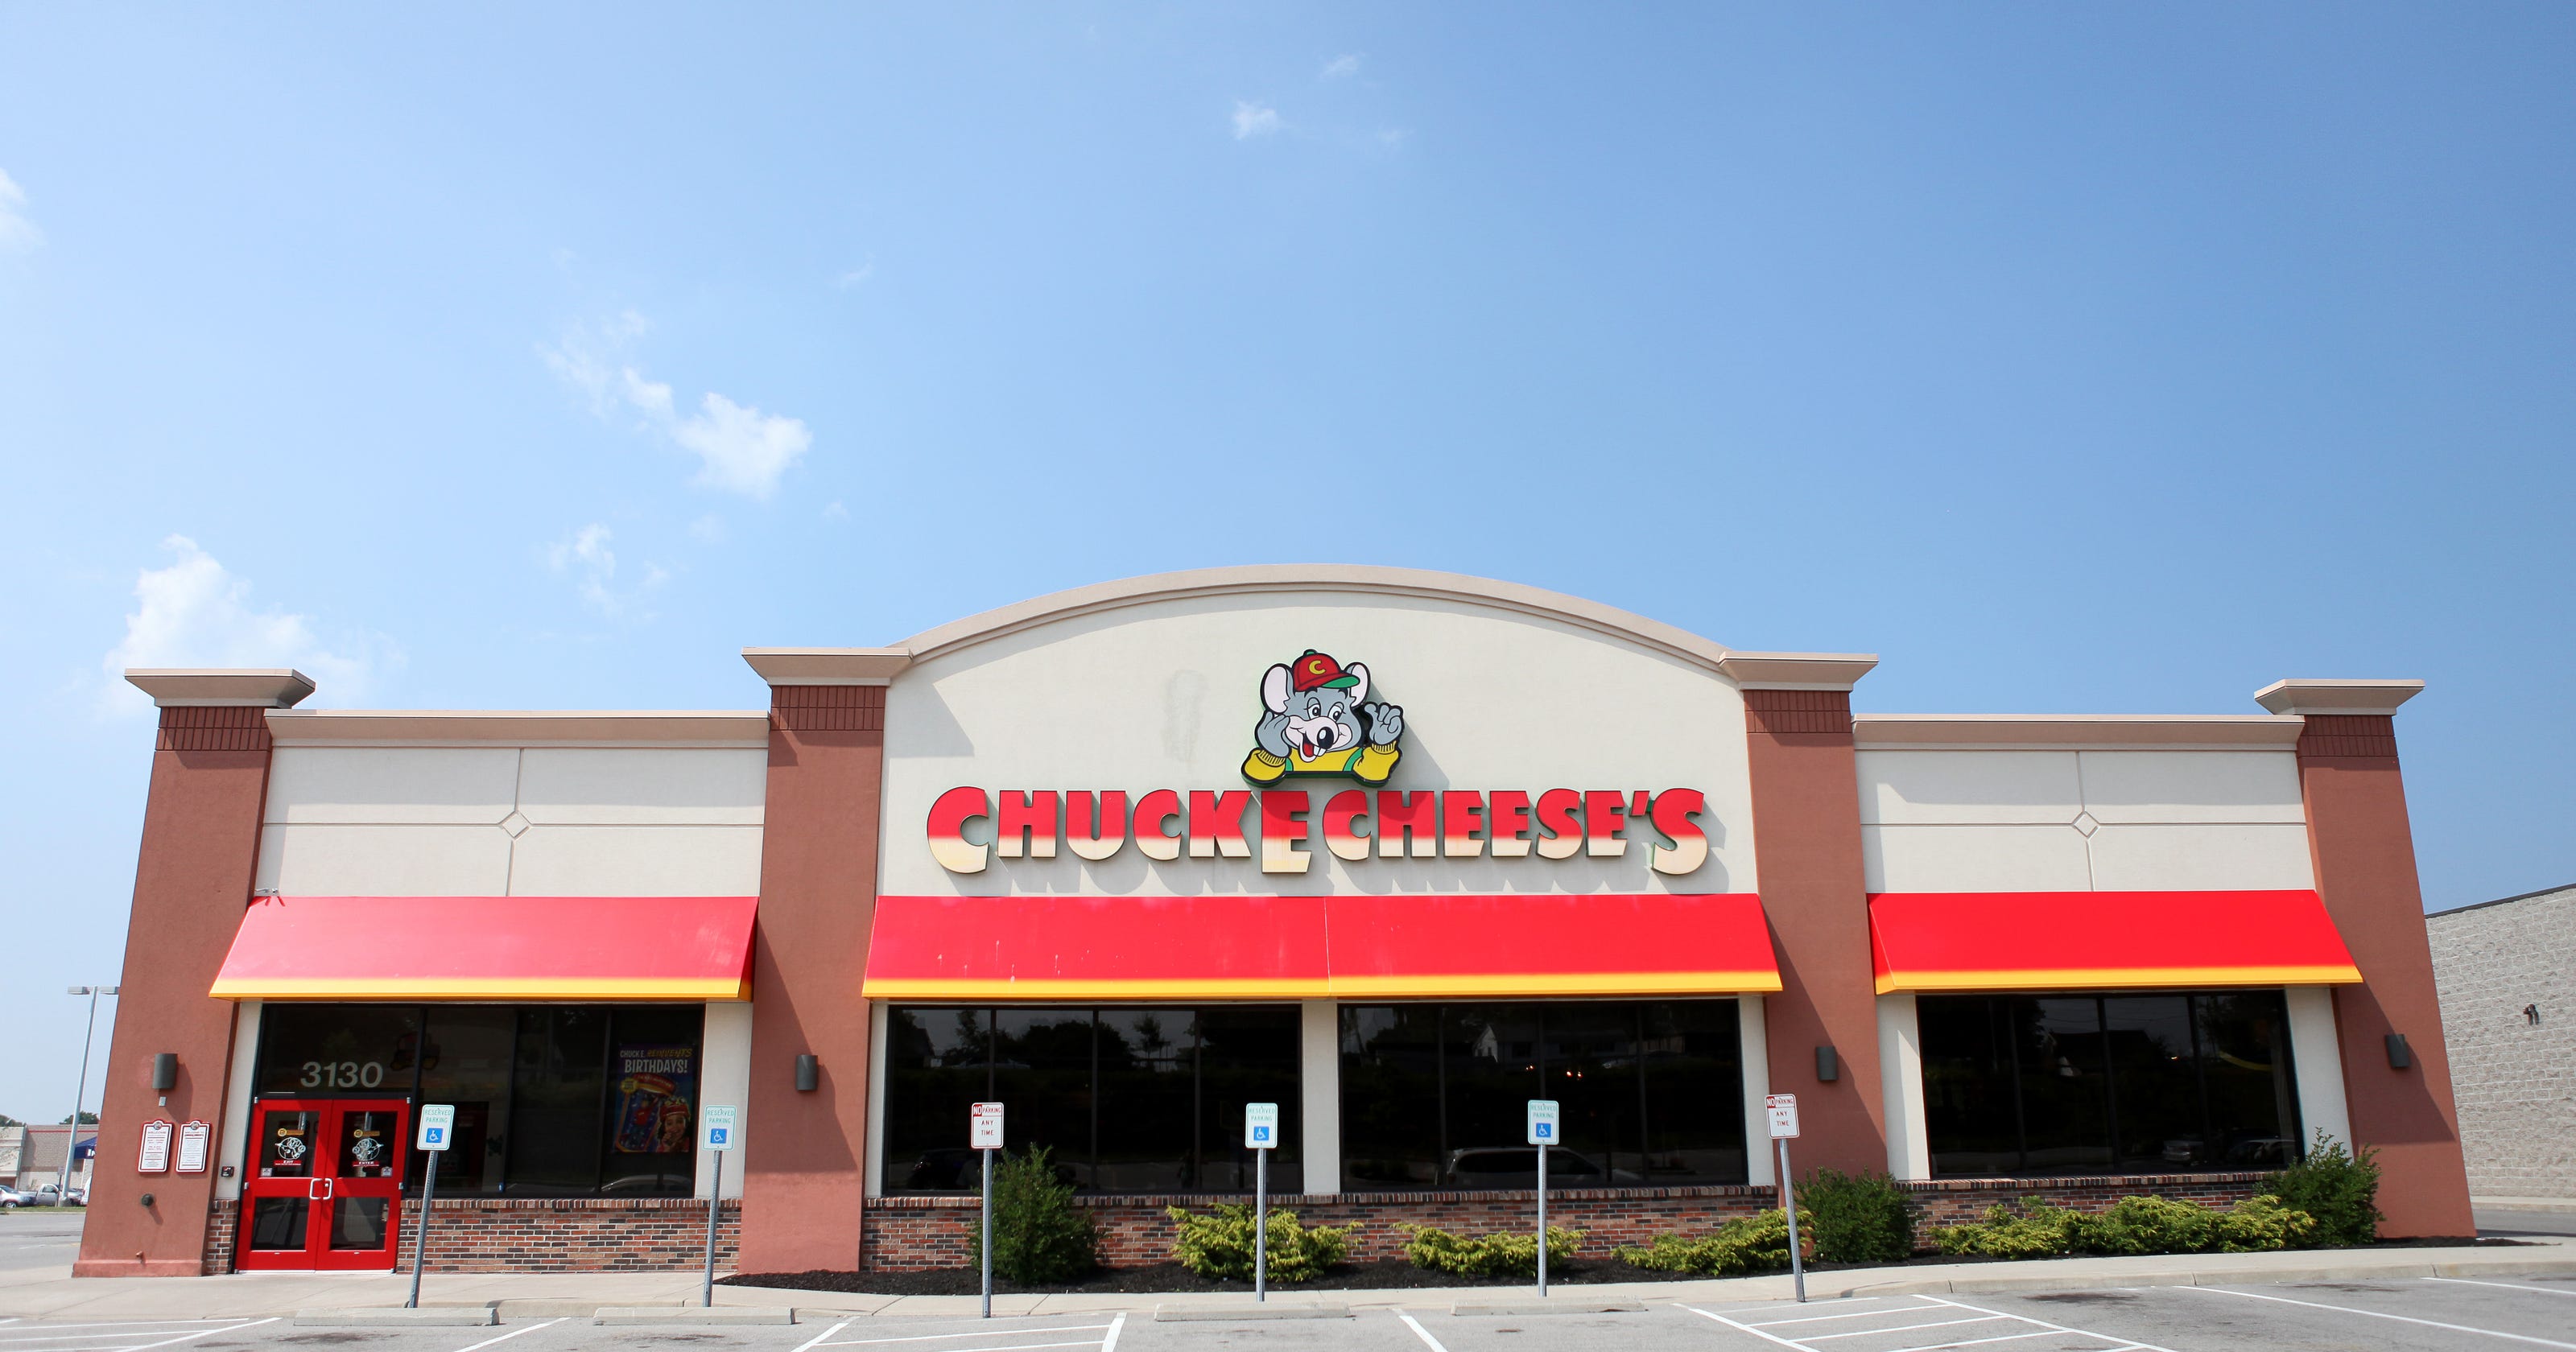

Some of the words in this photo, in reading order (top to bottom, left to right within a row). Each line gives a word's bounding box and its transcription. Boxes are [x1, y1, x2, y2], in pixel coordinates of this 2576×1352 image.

[1309, 660, 1326, 674] C
[927, 786, 1252, 873] CHUCK
[1261, 790, 1311, 873] E
[1323, 788, 1708, 875] CHEESE'S
[620, 1049, 640, 1057] CHUCK
[646, 1049, 692, 1057] REINVENTS
[624, 1059, 687, 1073] BIRTHDAYS!
[300, 1061, 383, 1087] 3130
[1767, 1098, 1775, 1107] NO
[973, 1106, 982, 1115] NO
